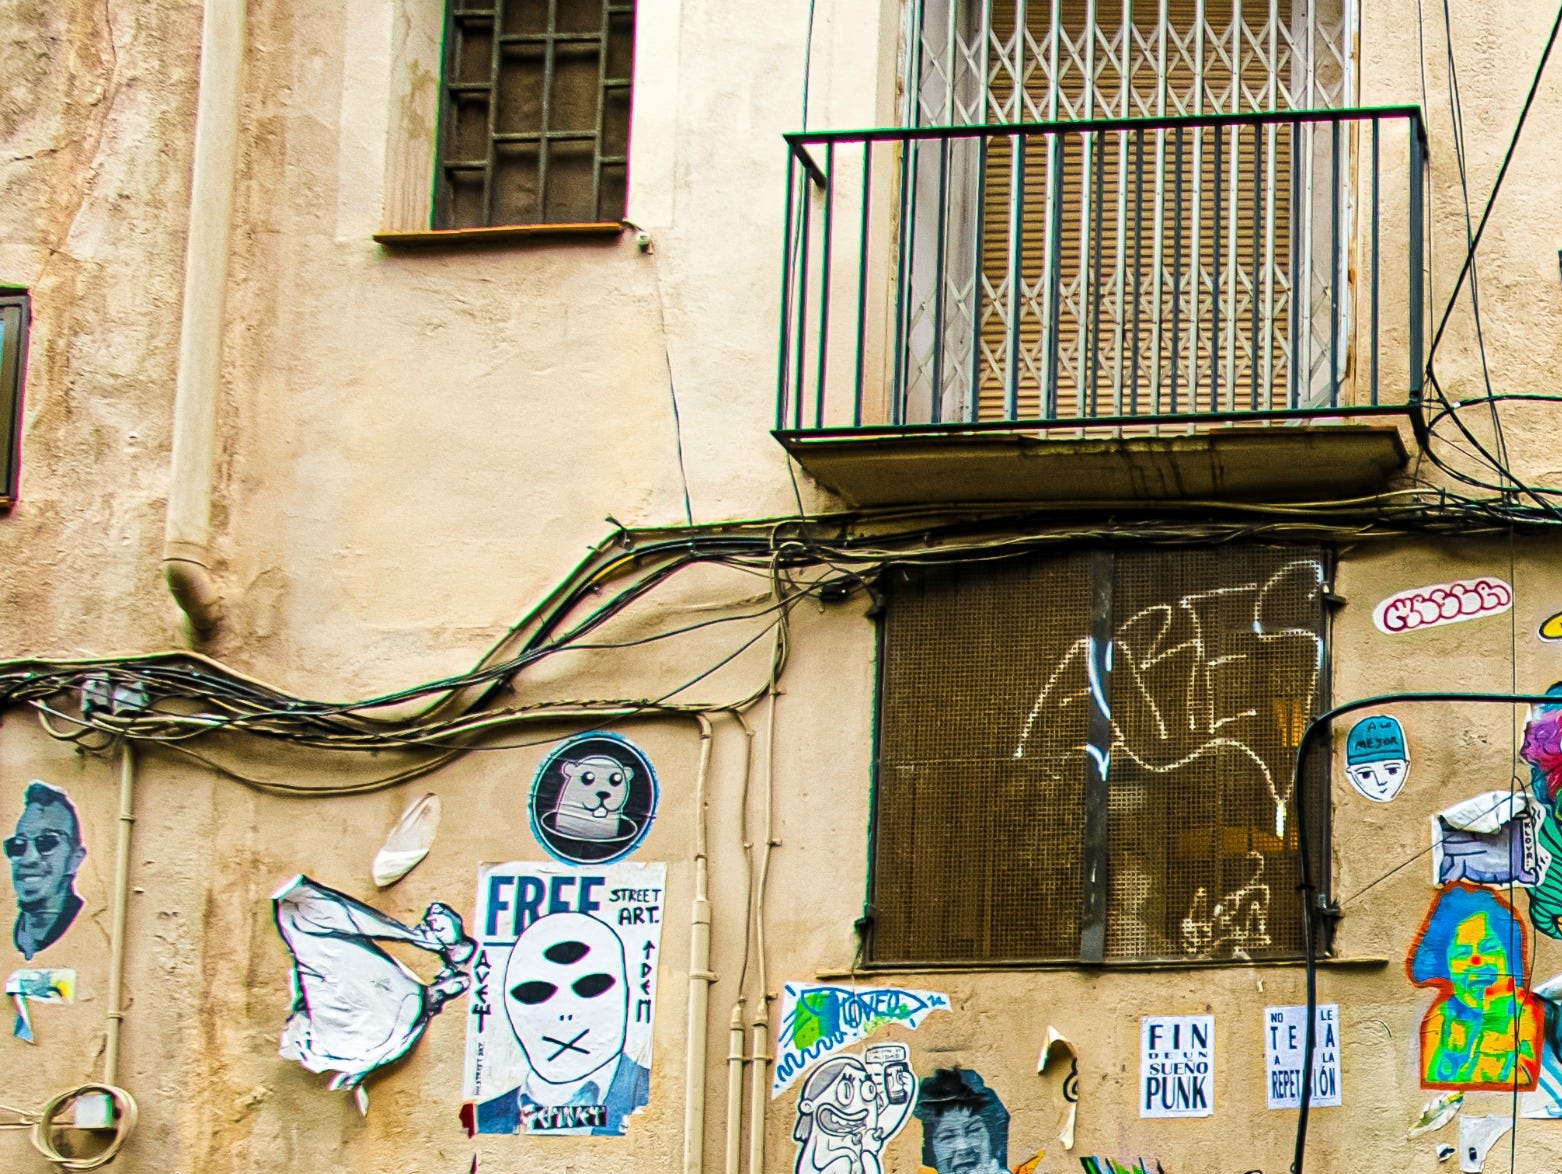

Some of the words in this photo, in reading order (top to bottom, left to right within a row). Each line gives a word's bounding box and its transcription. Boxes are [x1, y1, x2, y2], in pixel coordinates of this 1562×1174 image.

[486, 875, 606, 936] FREE
[608, 888, 662, 903] STREET
[1270, 1012, 1284, 1023] NO
[1320, 1009, 1333, 1021] LE
[1149, 1023, 1208, 1050] FIN
[1270, 1023, 1336, 1051] TEA
[1149, 1052, 1170, 1060] DE
[1184, 1051, 1208, 1059] UN
[1149, 1060, 1208, 1076] SUEÑO
[1274, 1055, 1281, 1066] A
[1322, 1052, 1335, 1063] LA
[1146, 1076, 1208, 1110] PUNK
[1271, 1066, 1336, 1100] REPETIÓN
